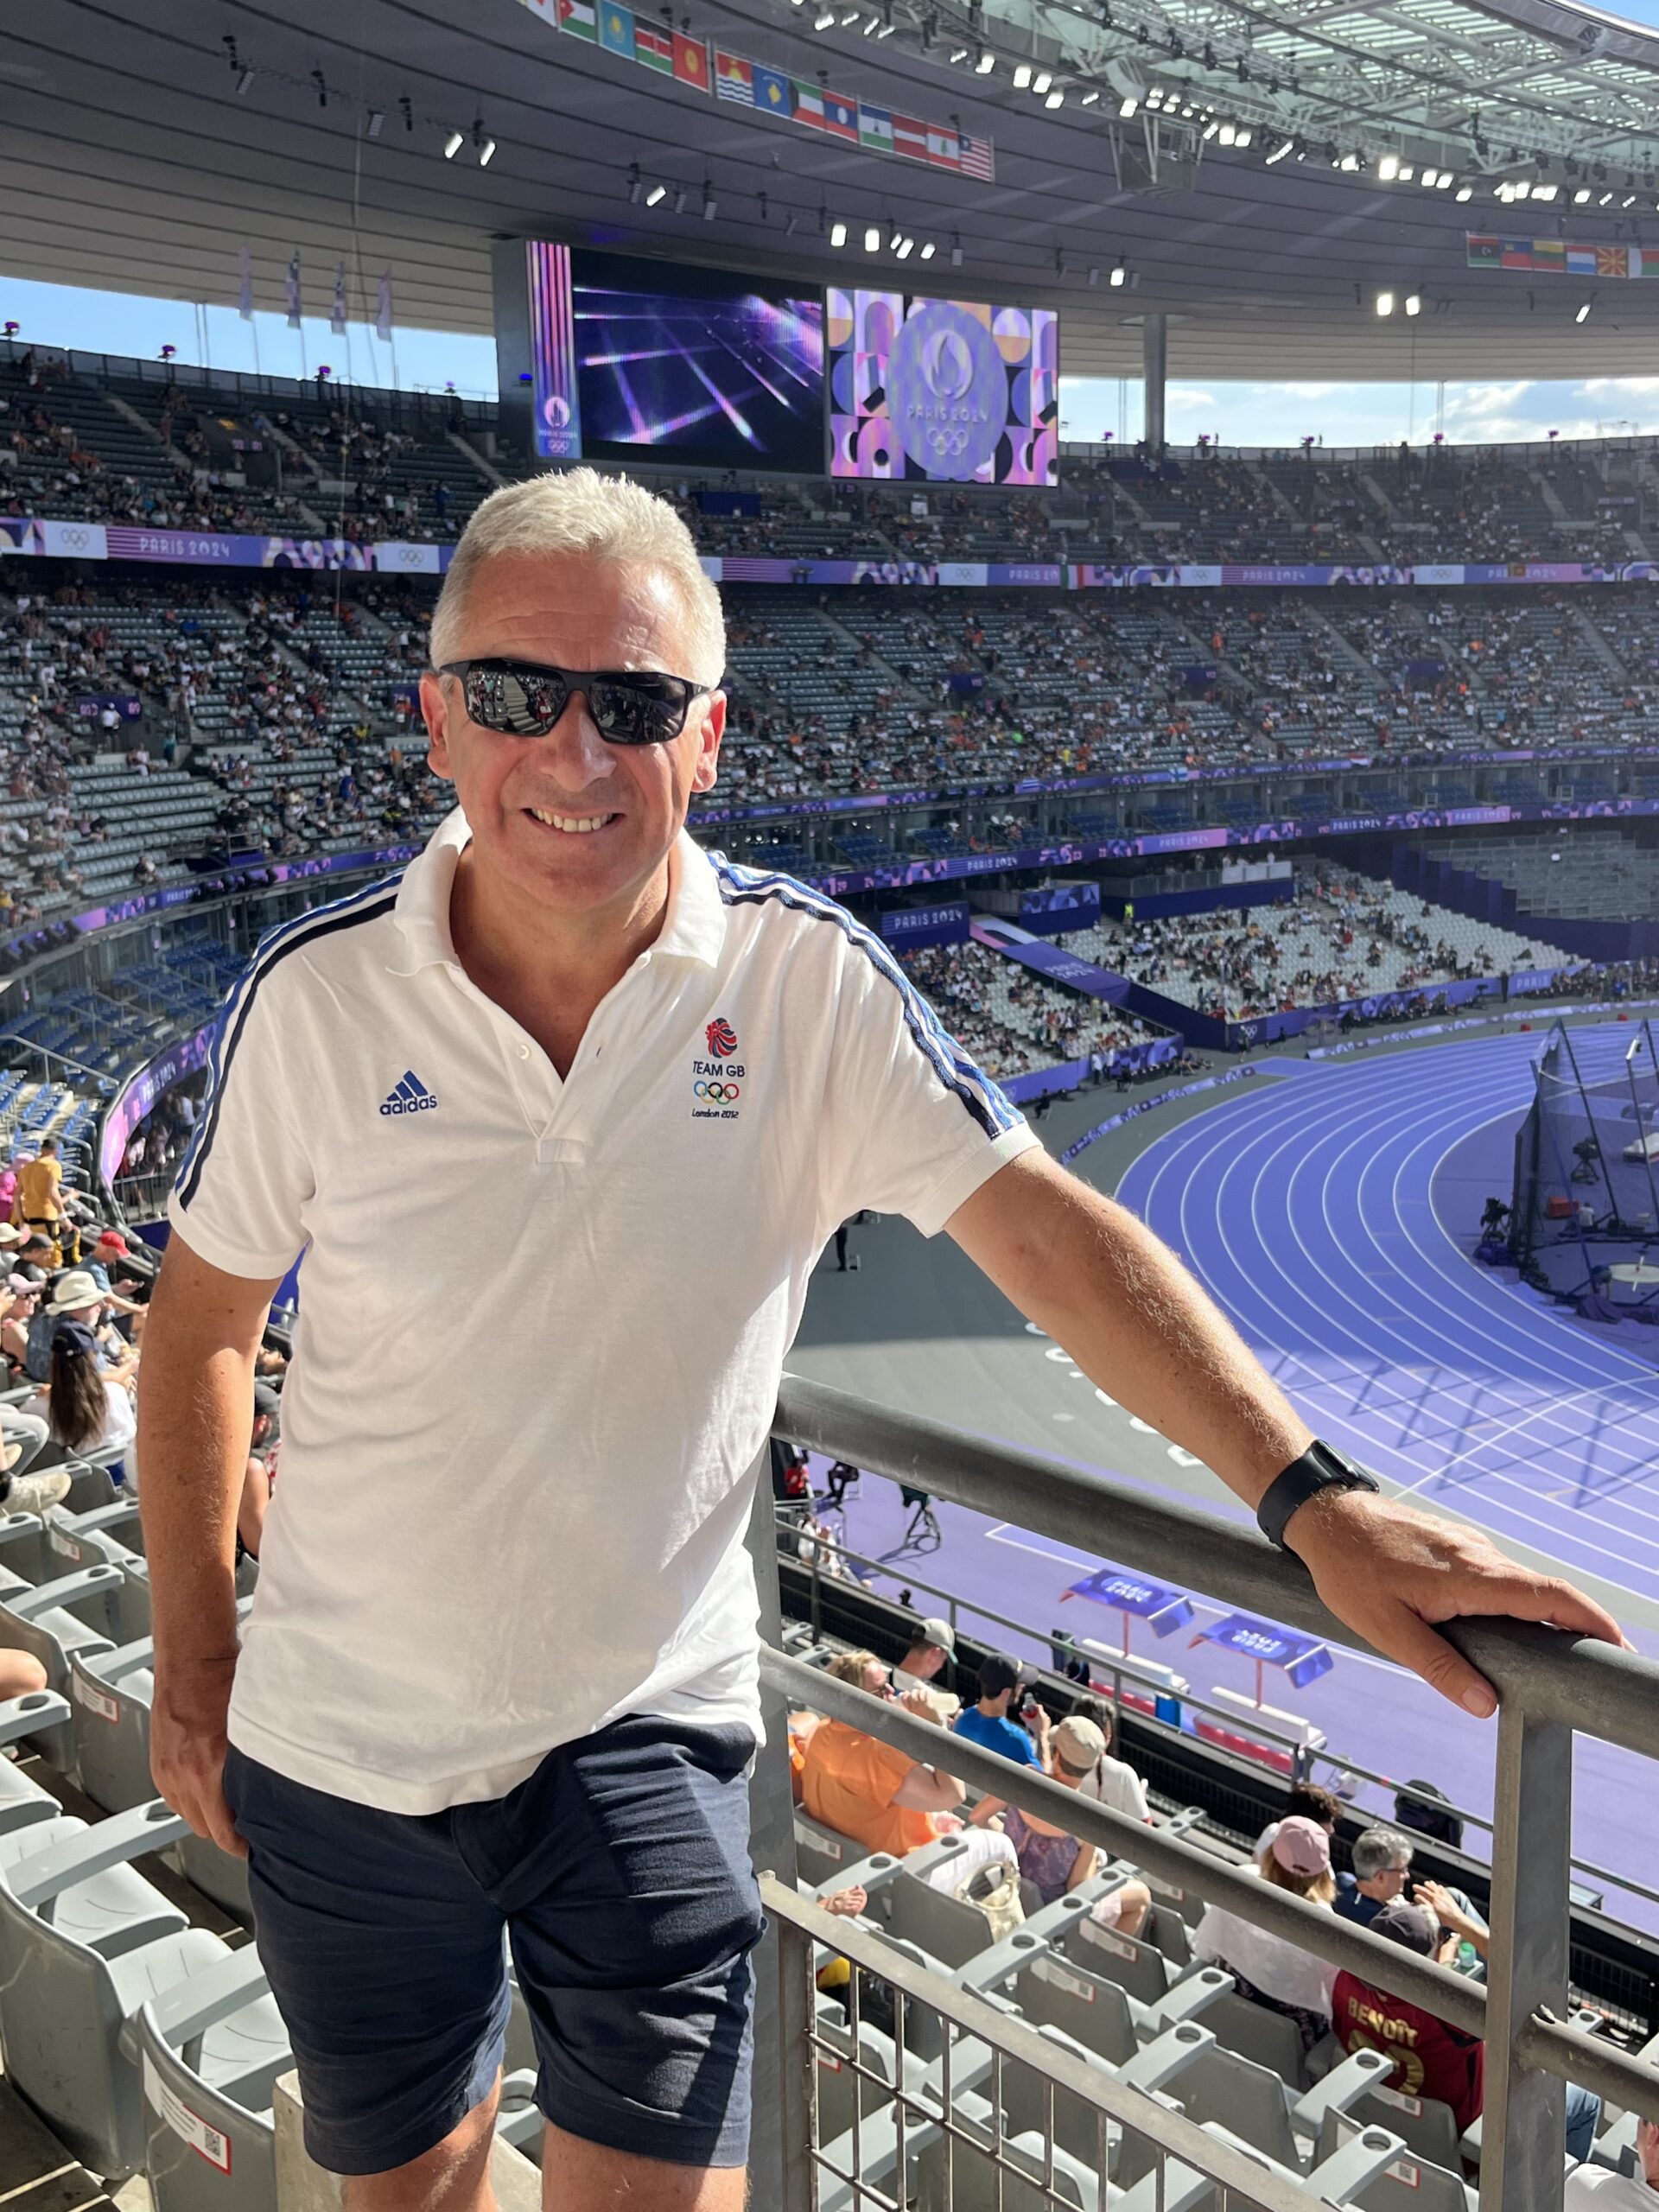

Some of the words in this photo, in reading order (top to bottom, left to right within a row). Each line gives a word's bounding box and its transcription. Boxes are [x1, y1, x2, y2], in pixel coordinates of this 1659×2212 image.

[906, 404, 948, 422] PARIS
[140, 537, 184, 556] PARIS
[188, 539, 230, 557] 2024
[1008, 569, 1041, 582] PARIS
[1043, 569, 1058, 582] 20
[1243, 570, 1274, 582] PARIS
[1276, 570, 1306, 582] 2024
[1332, 821, 1357, 831] PARIS
[1358, 818, 1381, 830] 2024
[1160, 836, 1185, 848] PARIS
[1186, 834, 1209, 846] 2024
[967, 858, 994, 871] PARIS
[995, 855, 1018, 868] 2024
[894, 913, 929, 930] PARIS
[931, 909, 963, 925] 2024
[1516, 975, 1548, 989] PARIS
[693, 1060, 723, 1077] TEAM
[726, 1065, 746, 1077] GB
[379, 1095, 438, 1116] adidas
[691, 1108, 721, 1118] London
[721, 1109, 740, 1119] 2012
[1348, 1996, 1419, 2048] BENOÎT
